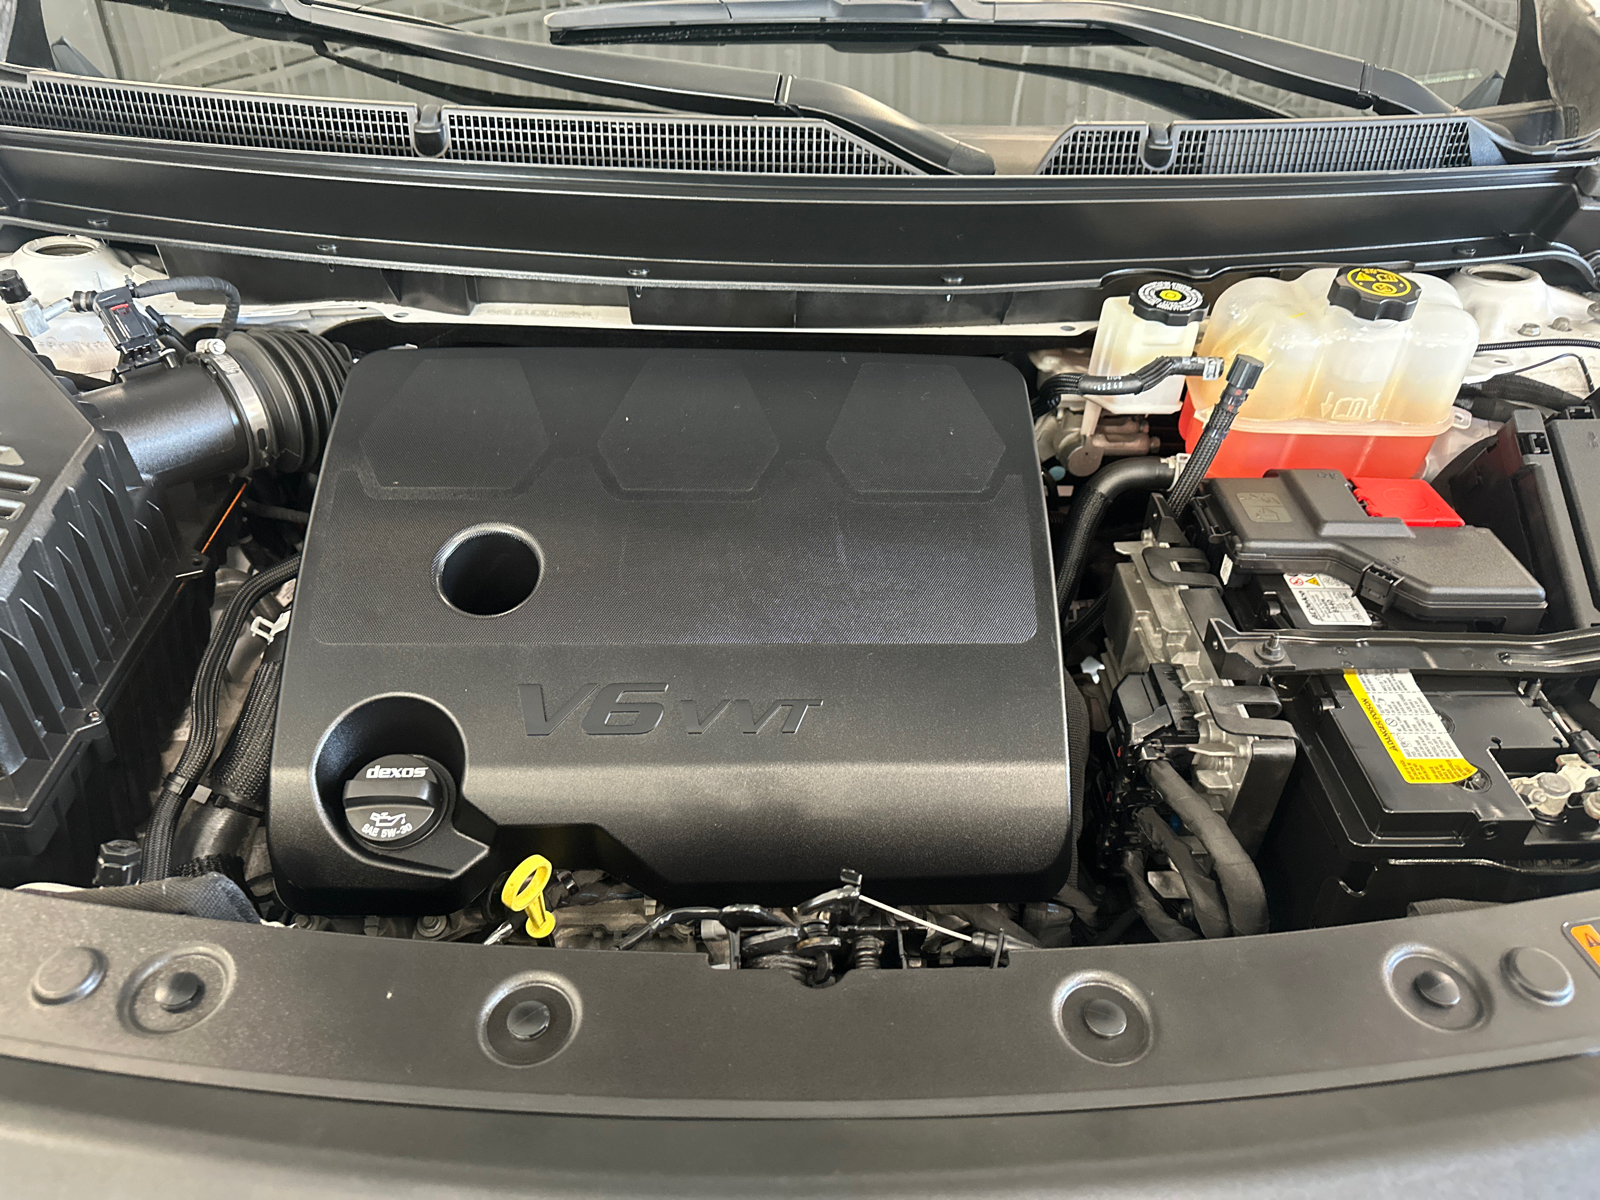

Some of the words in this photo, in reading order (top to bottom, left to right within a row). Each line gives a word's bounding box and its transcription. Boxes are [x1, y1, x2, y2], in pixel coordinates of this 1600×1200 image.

[518, 682, 669, 736] V6
[681, 699, 824, 735] VVT
[365, 764, 430, 779] dexos
[361, 823, 380, 838] SAE
[380, 822, 413, 839] 5W-30
